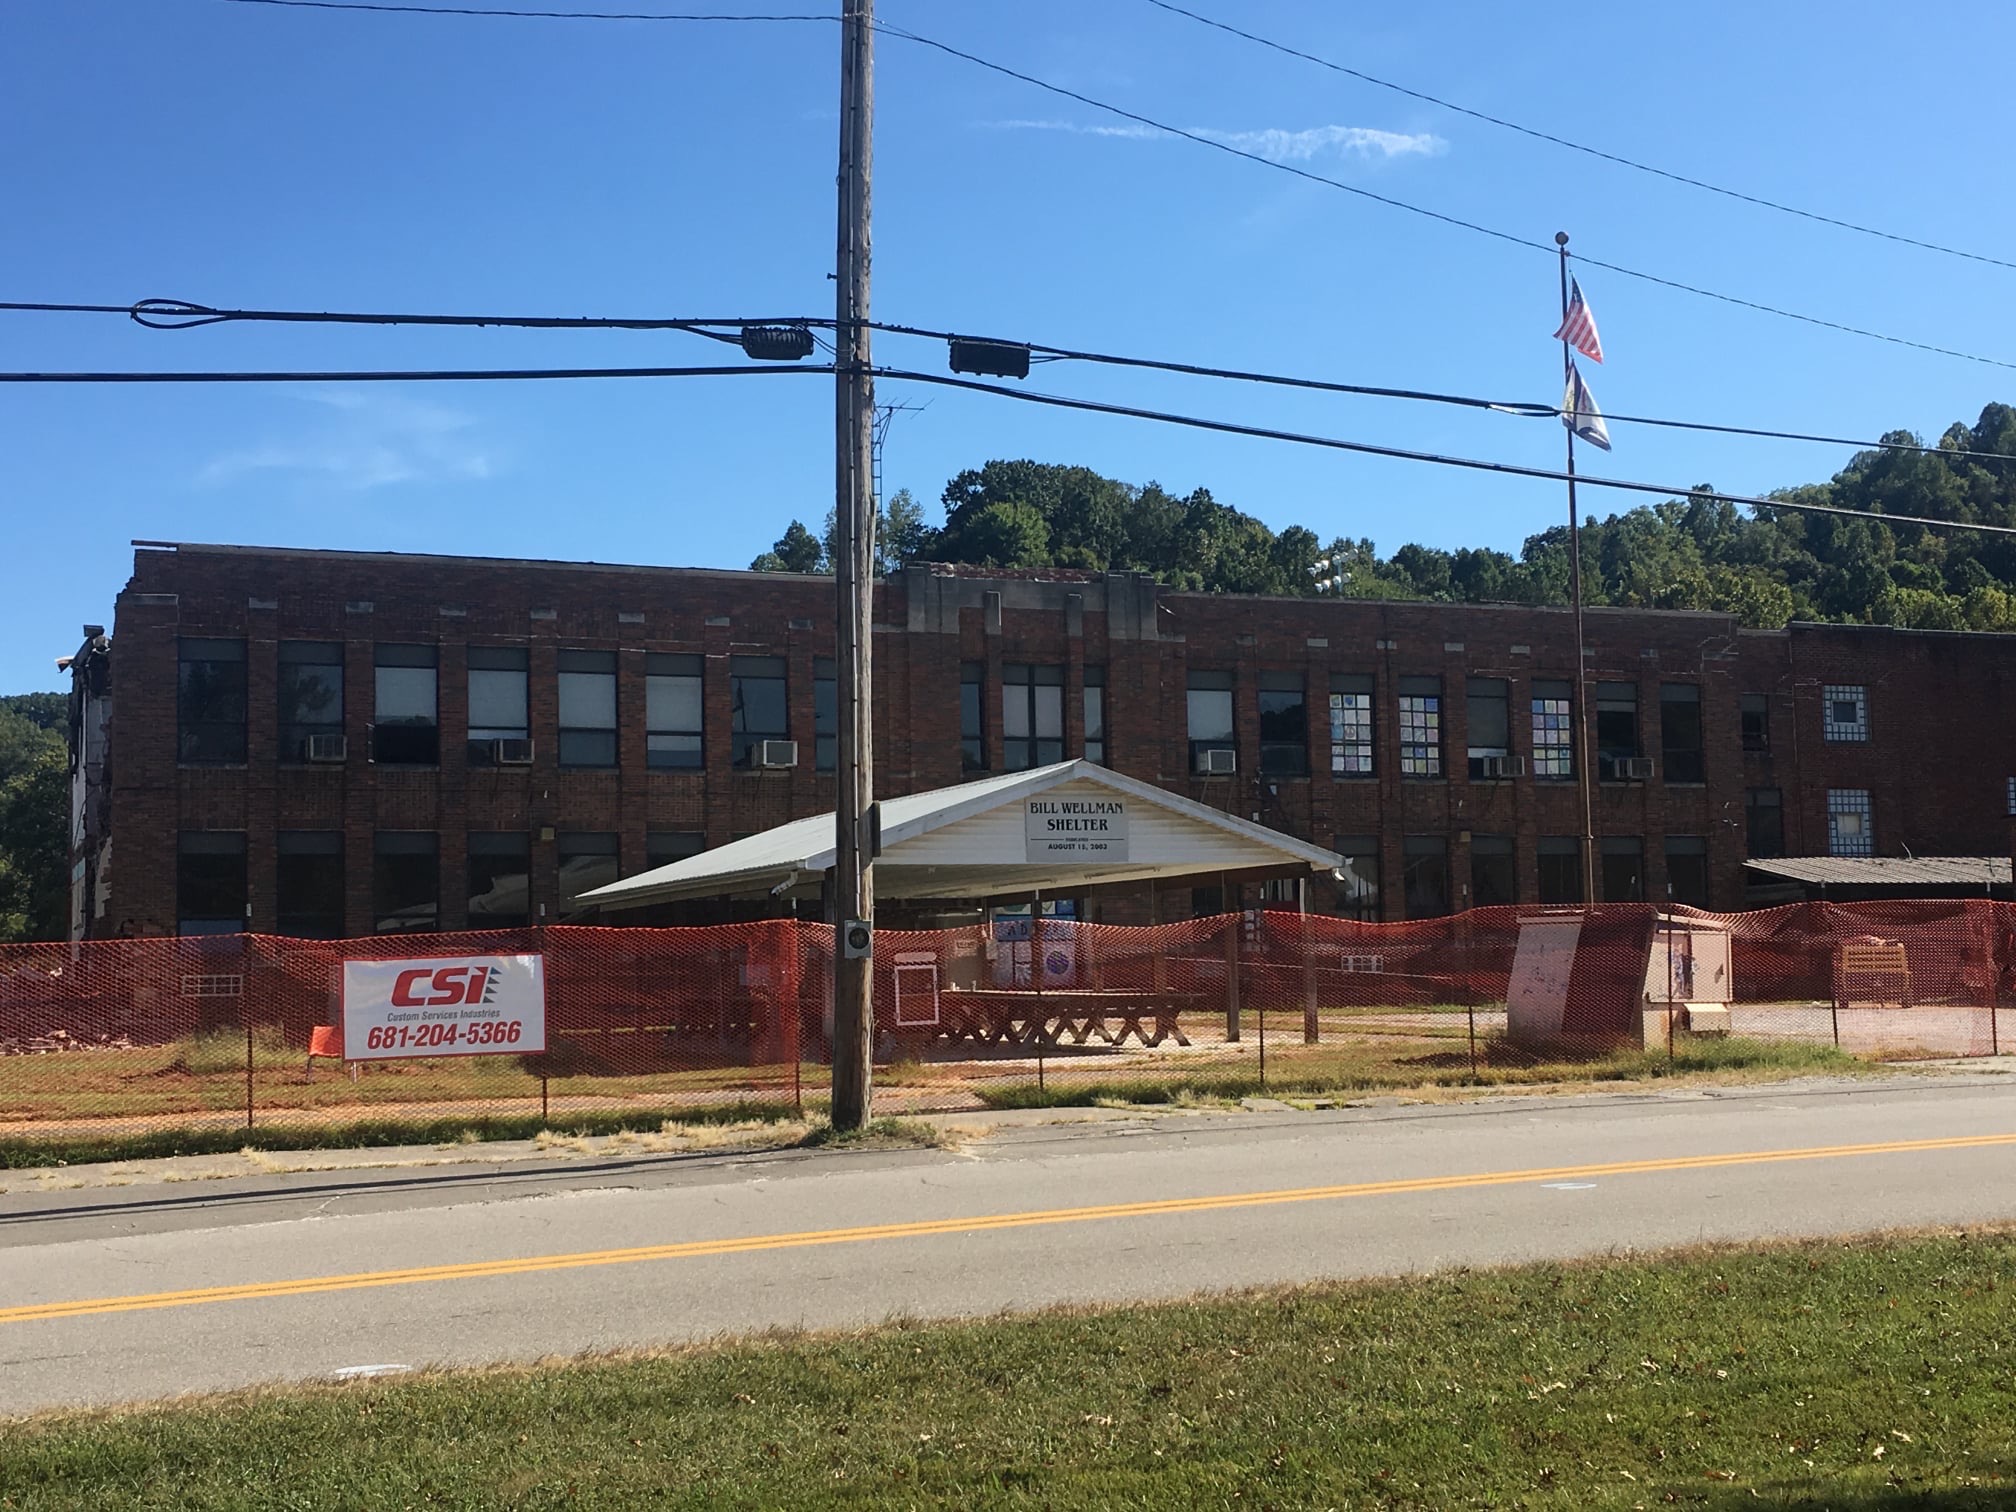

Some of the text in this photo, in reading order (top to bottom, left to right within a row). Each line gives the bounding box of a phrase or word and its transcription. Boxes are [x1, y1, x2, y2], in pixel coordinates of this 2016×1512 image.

[1030, 802, 1123, 814] BILL WELLMAN
[1047, 819, 1108, 831] SHELTER
[387, 1008, 500, 1022] Custom Services Industries
[367, 1021, 522, 1049] 681-204-5366
